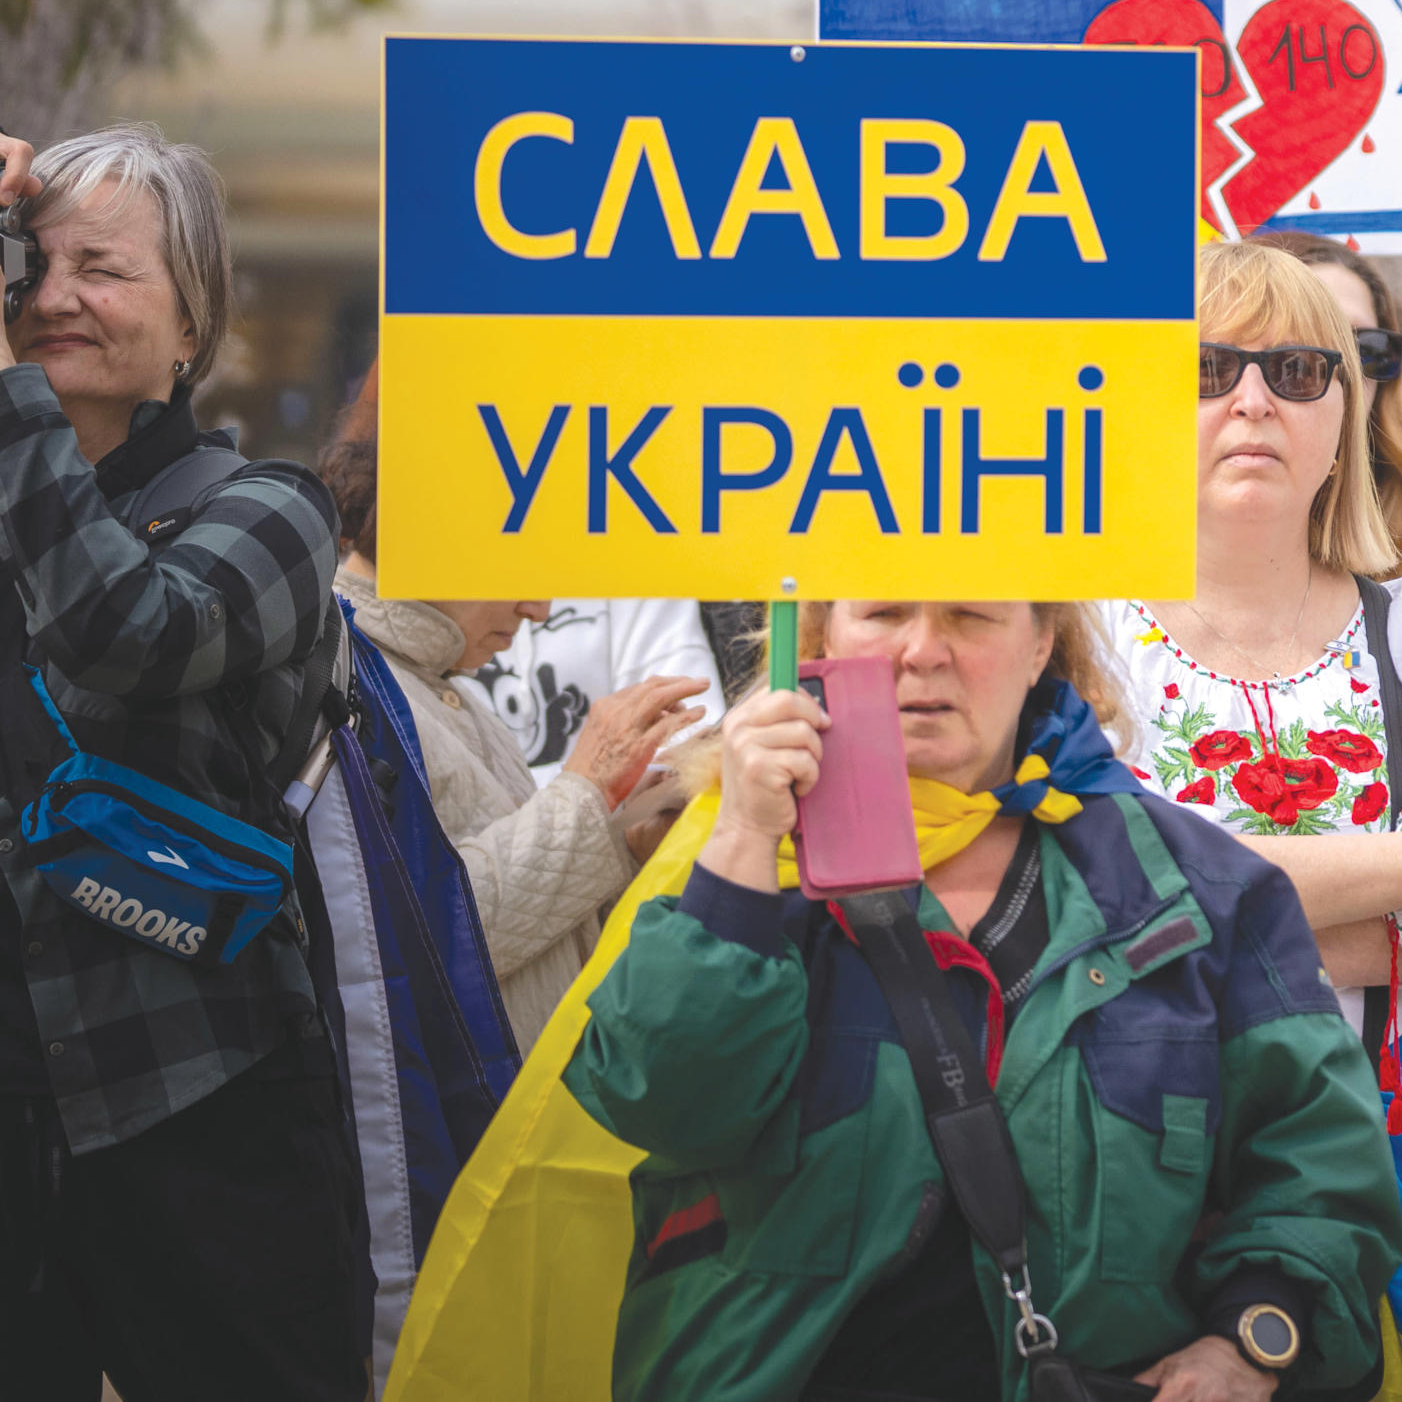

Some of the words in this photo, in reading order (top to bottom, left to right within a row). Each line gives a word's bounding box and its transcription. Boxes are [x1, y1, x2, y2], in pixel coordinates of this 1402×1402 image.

[1267, 22, 1377, 91] 140
[474, 111, 1107, 262] СЛАВА
[476, 361, 1105, 535] УКРАЇНІ
[71, 876, 207, 955] BROOKS
